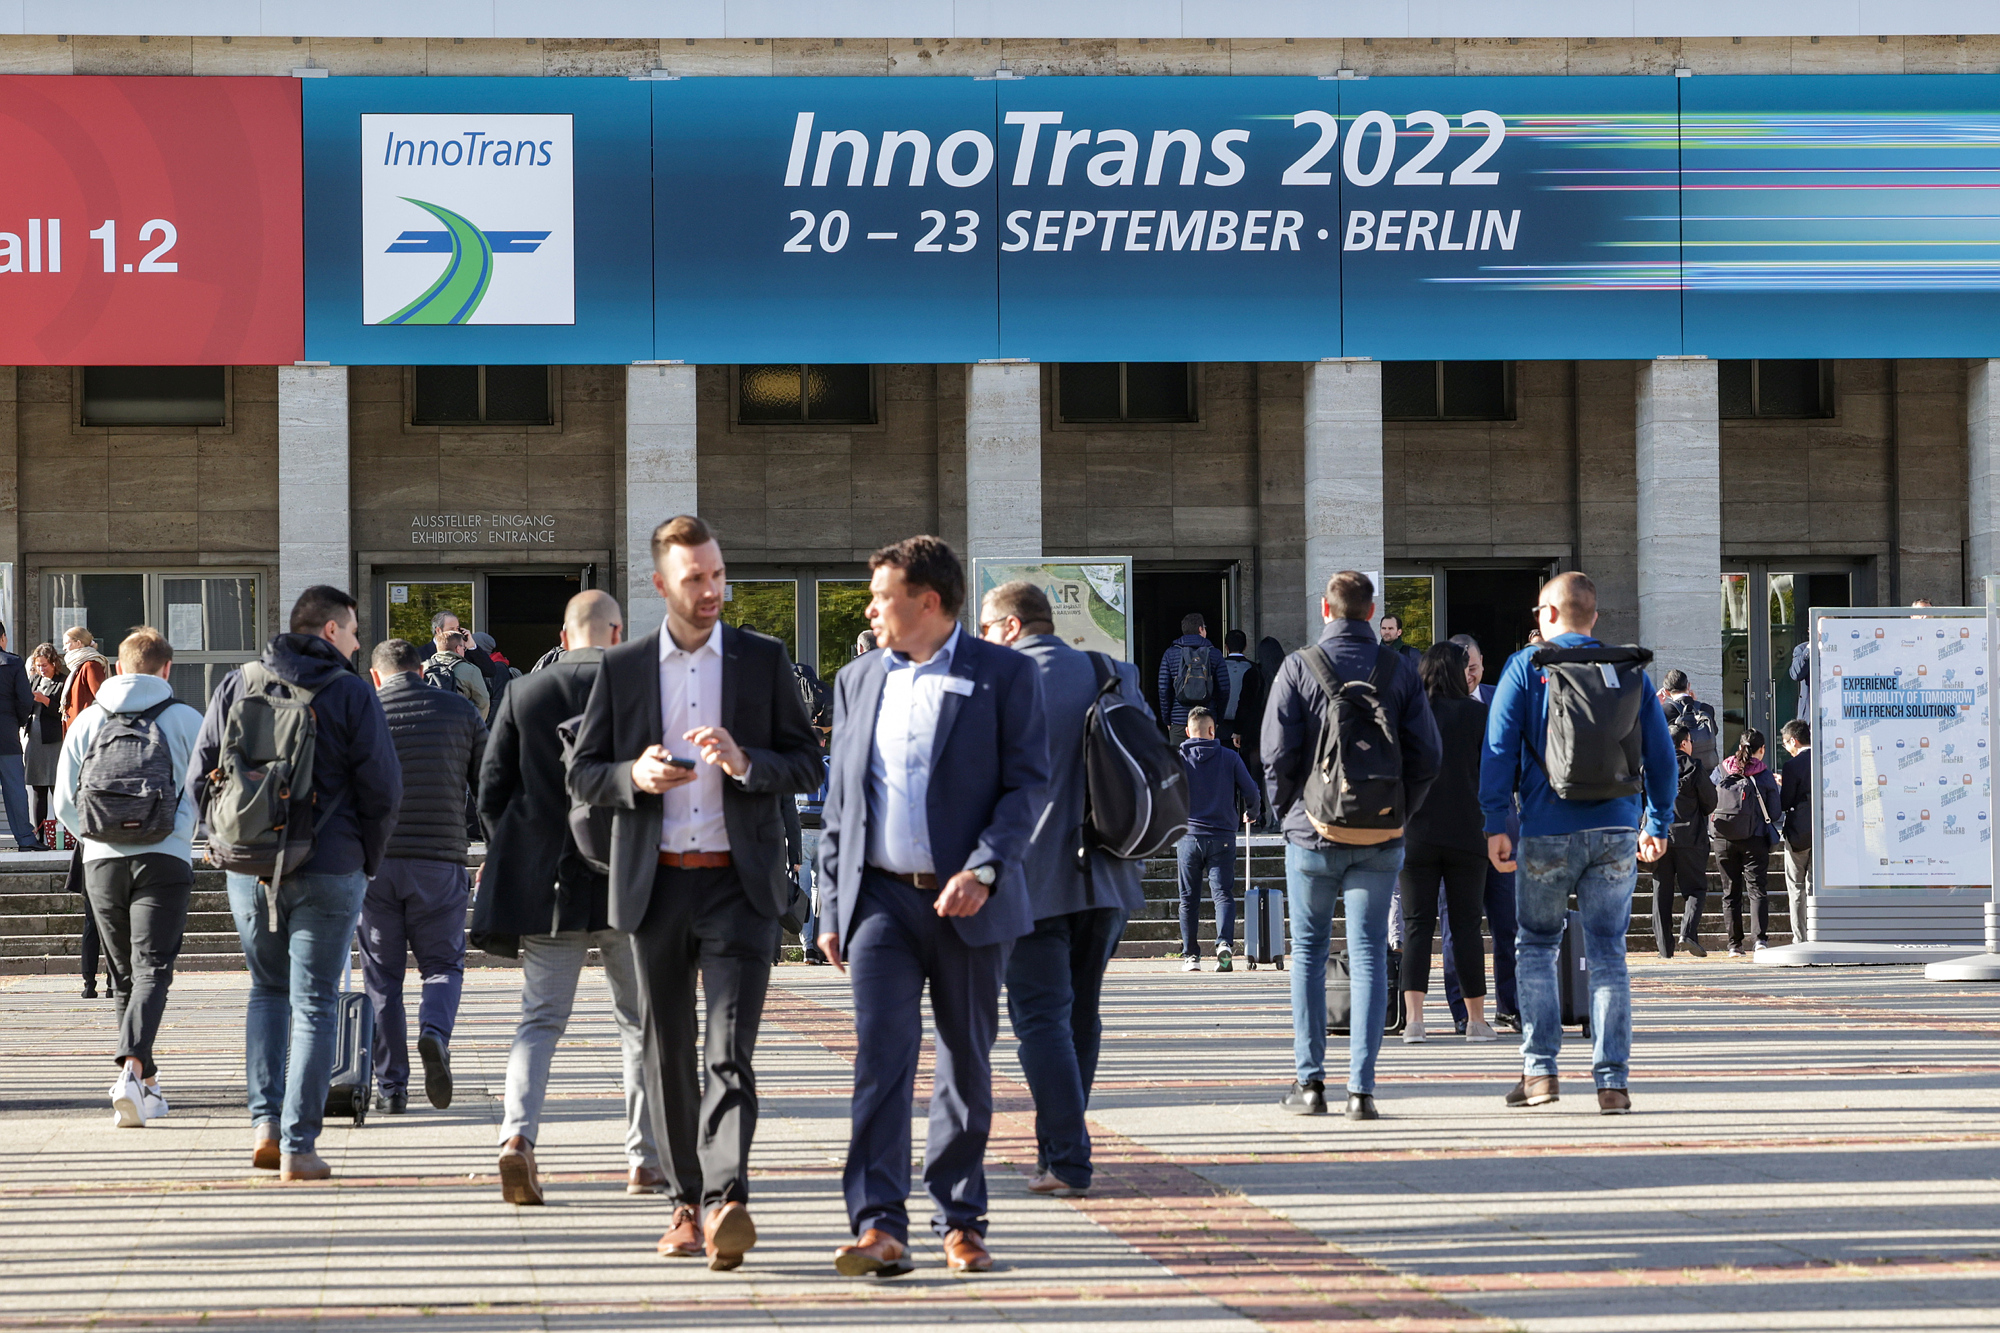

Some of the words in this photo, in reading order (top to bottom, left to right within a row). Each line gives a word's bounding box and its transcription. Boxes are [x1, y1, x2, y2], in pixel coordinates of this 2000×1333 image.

[384, 131, 553, 167] InnoTrans
[784, 110, 1250, 187] InnoTrans
[1281, 109, 1507, 186] 2022
[783, 209, 850, 253] 20
[913, 209, 980, 253] 23
[1001, 209, 1303, 252] SEPTEMBER
[1343, 209, 1521, 251] BERLIN
[89, 218, 178, 273] 1.2
[488, 530, 555, 543] ENTRANCE
[1843, 677, 1897, 690] EXPERIENCE
[1843, 691, 1861, 704] THE
[1863, 691, 1905, 704] MOBILITY
[1907, 690, 1919, 704] OF
[1921, 690, 1973, 704] TOMORROW
[1843, 705, 1867, 718] WITH
[1869, 705, 1903, 718] FRENCH
[1906, 704, 1956, 718] SOLUTIONS
